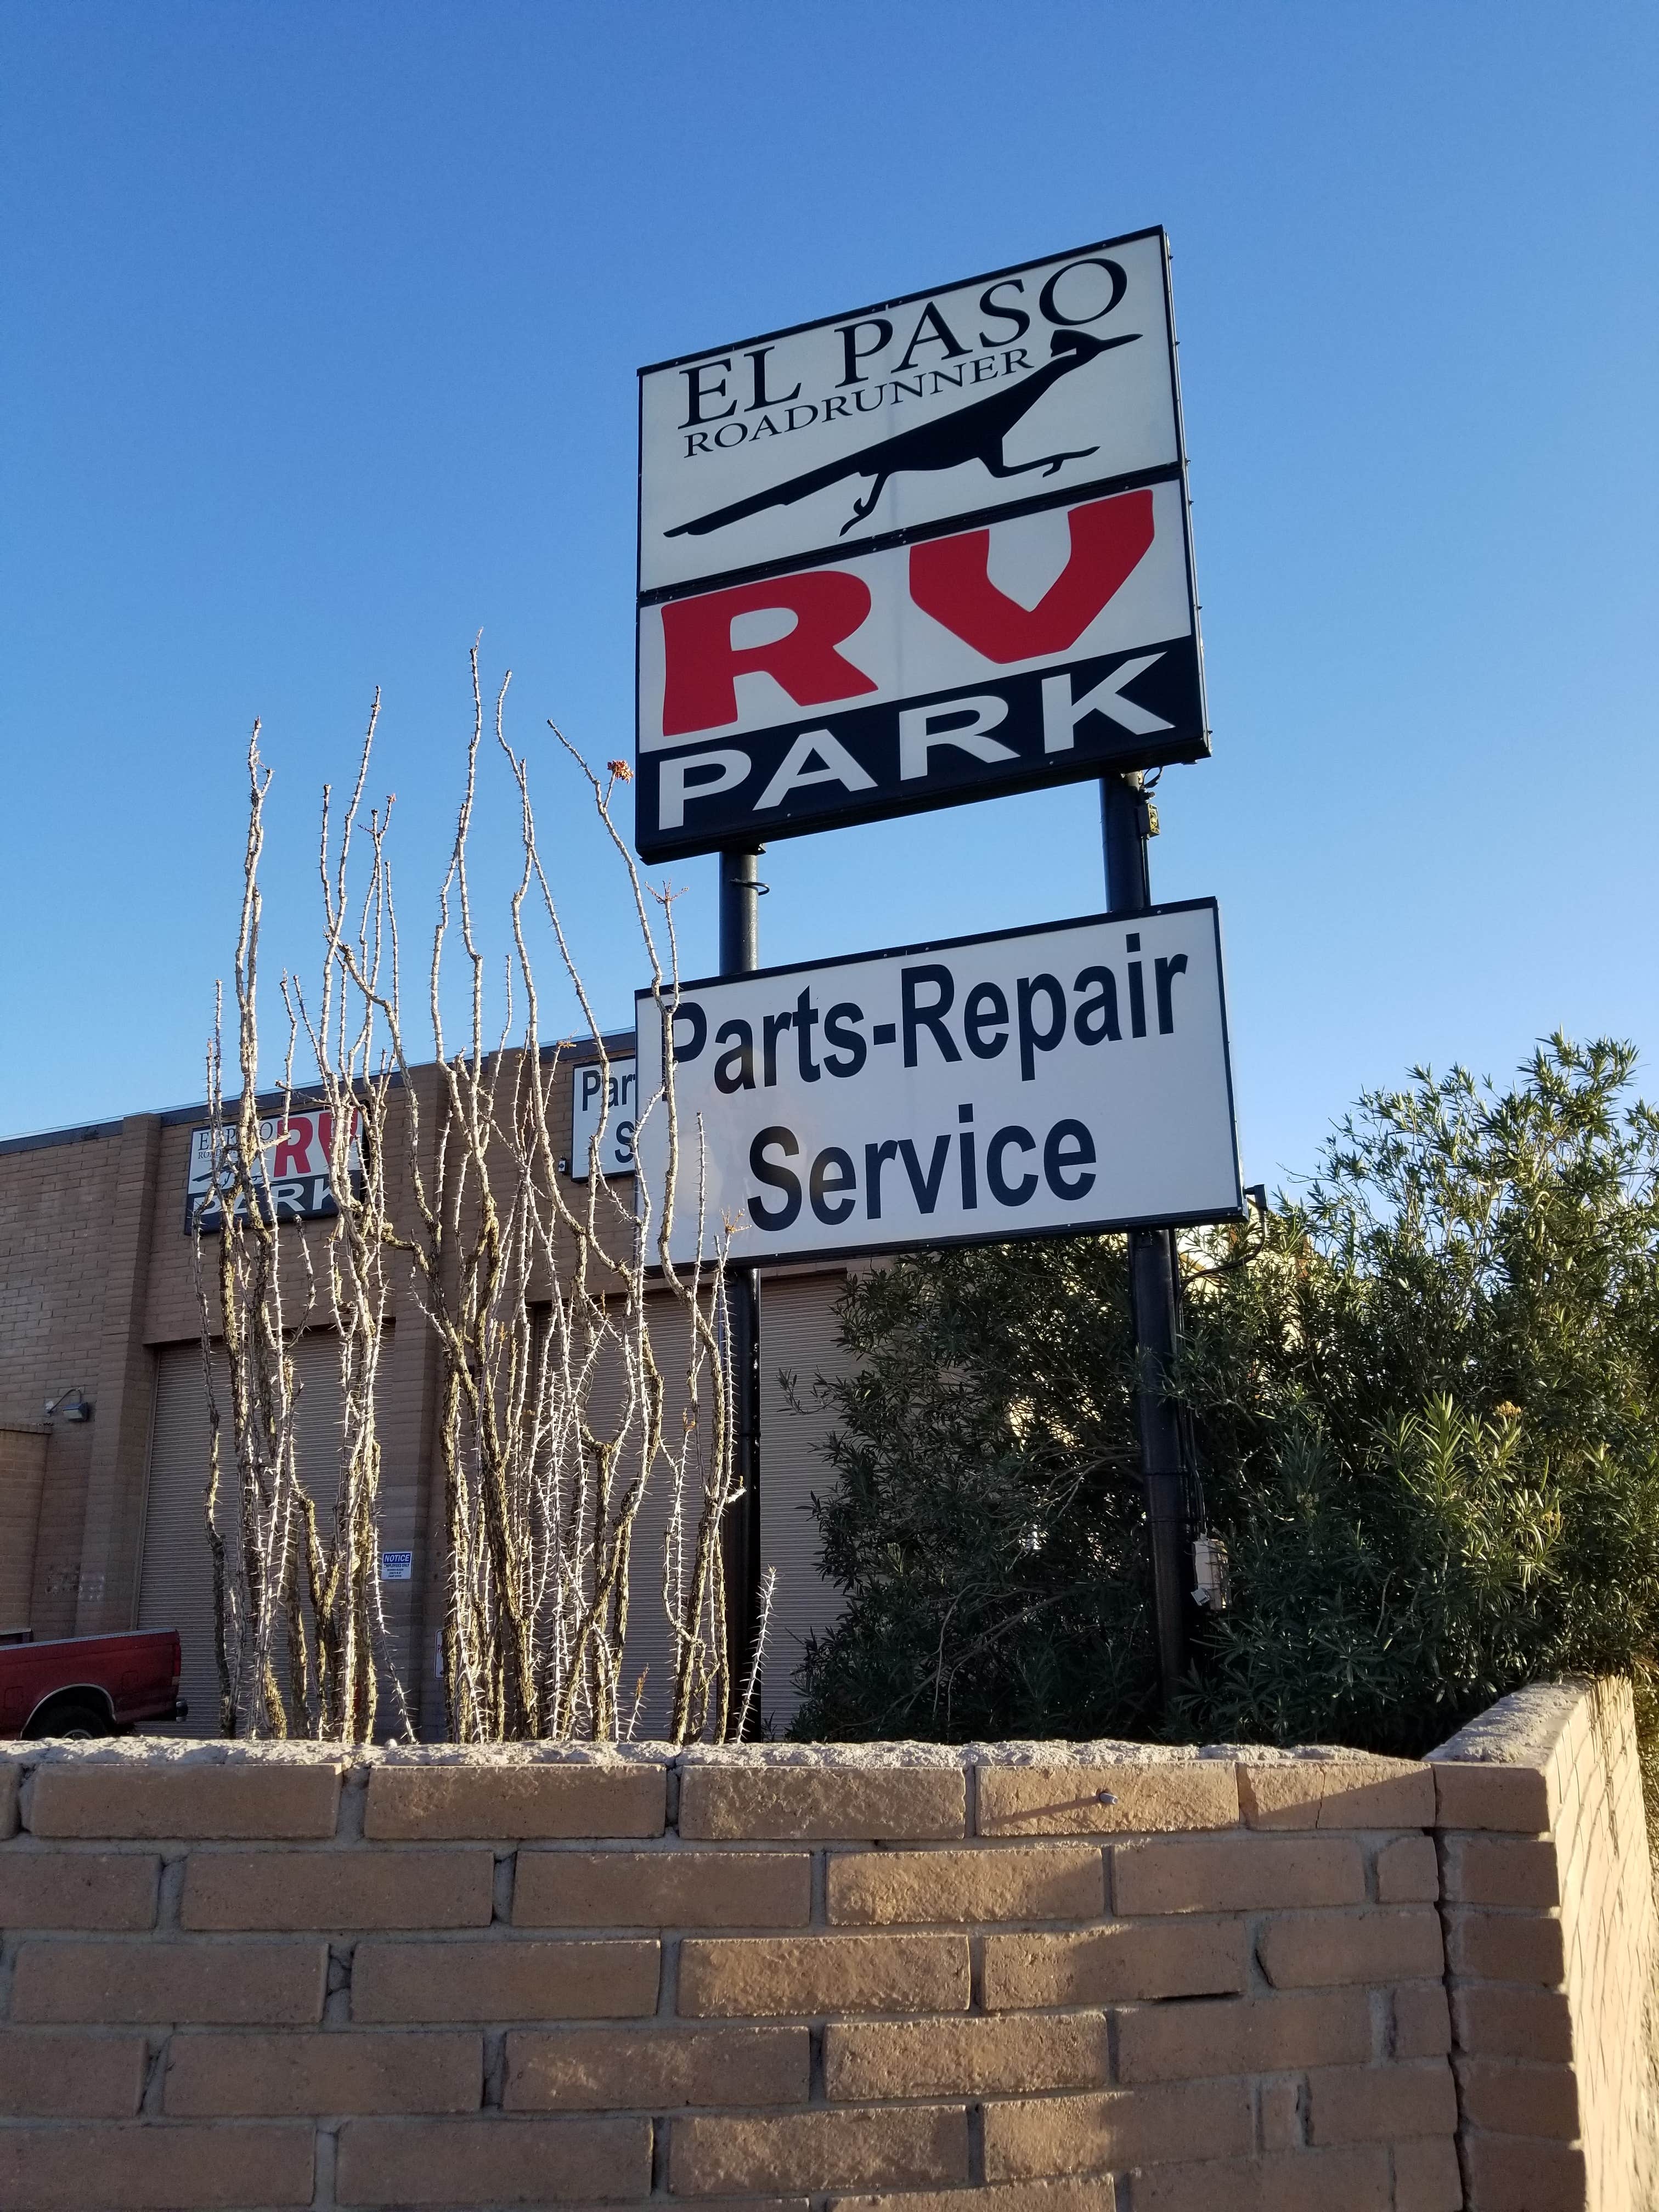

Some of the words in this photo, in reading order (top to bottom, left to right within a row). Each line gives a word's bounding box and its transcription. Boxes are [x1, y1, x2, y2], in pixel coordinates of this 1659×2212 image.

[678, 346, 802, 430] EL
[834, 258, 1127, 388] PASO
[684, 348, 1035, 458] ROADRUNNER
[661, 488, 1154, 736] RV
[659, 652, 1175, 831] PARK
[662, 933, 1188, 1101] Parts-Repair
[748, 1103, 1097, 1232] Service
[384, 1554, 410, 1562] NOTICE
